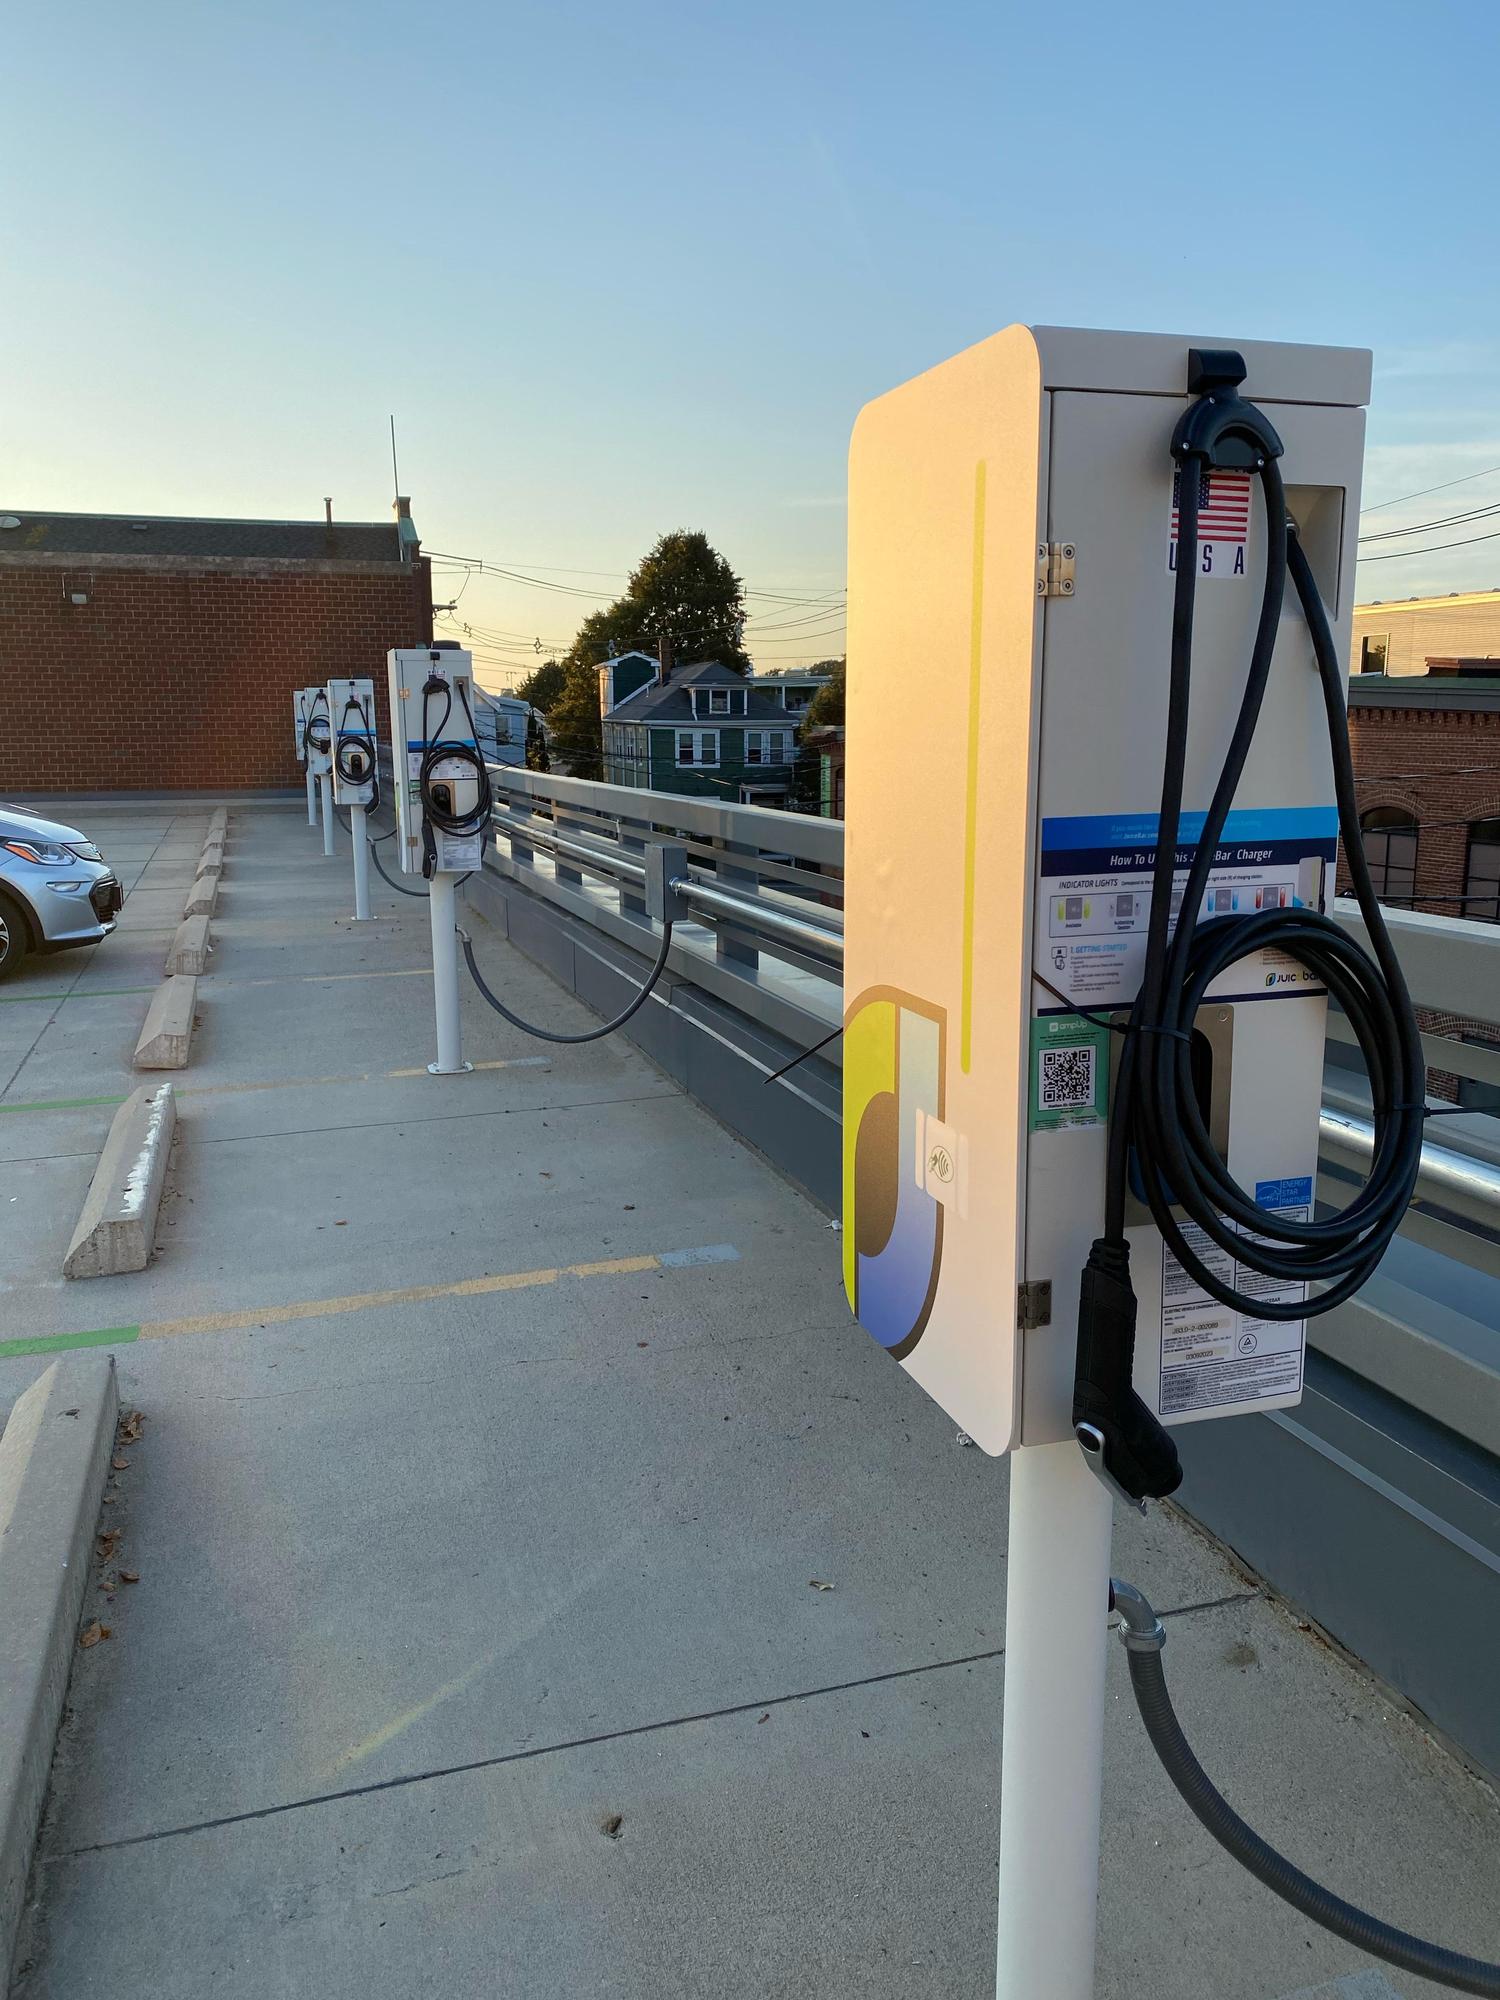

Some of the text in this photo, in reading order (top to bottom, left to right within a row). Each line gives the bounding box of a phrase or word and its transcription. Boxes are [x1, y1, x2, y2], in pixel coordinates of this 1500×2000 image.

[1110, 855, 1132, 866] How
[1135, 853, 1146, 864] To
[1237, 849, 1273, 862] Charger
[1059, 879, 1094, 889] INDICATOR
[1095, 878, 1118, 887] LIGHTS
[1282, 1180, 1306, 1189] ENERGY
[1281, 1188, 1298, 1196] STAR
[1281, 1194, 1311, 1204] PARTNER
